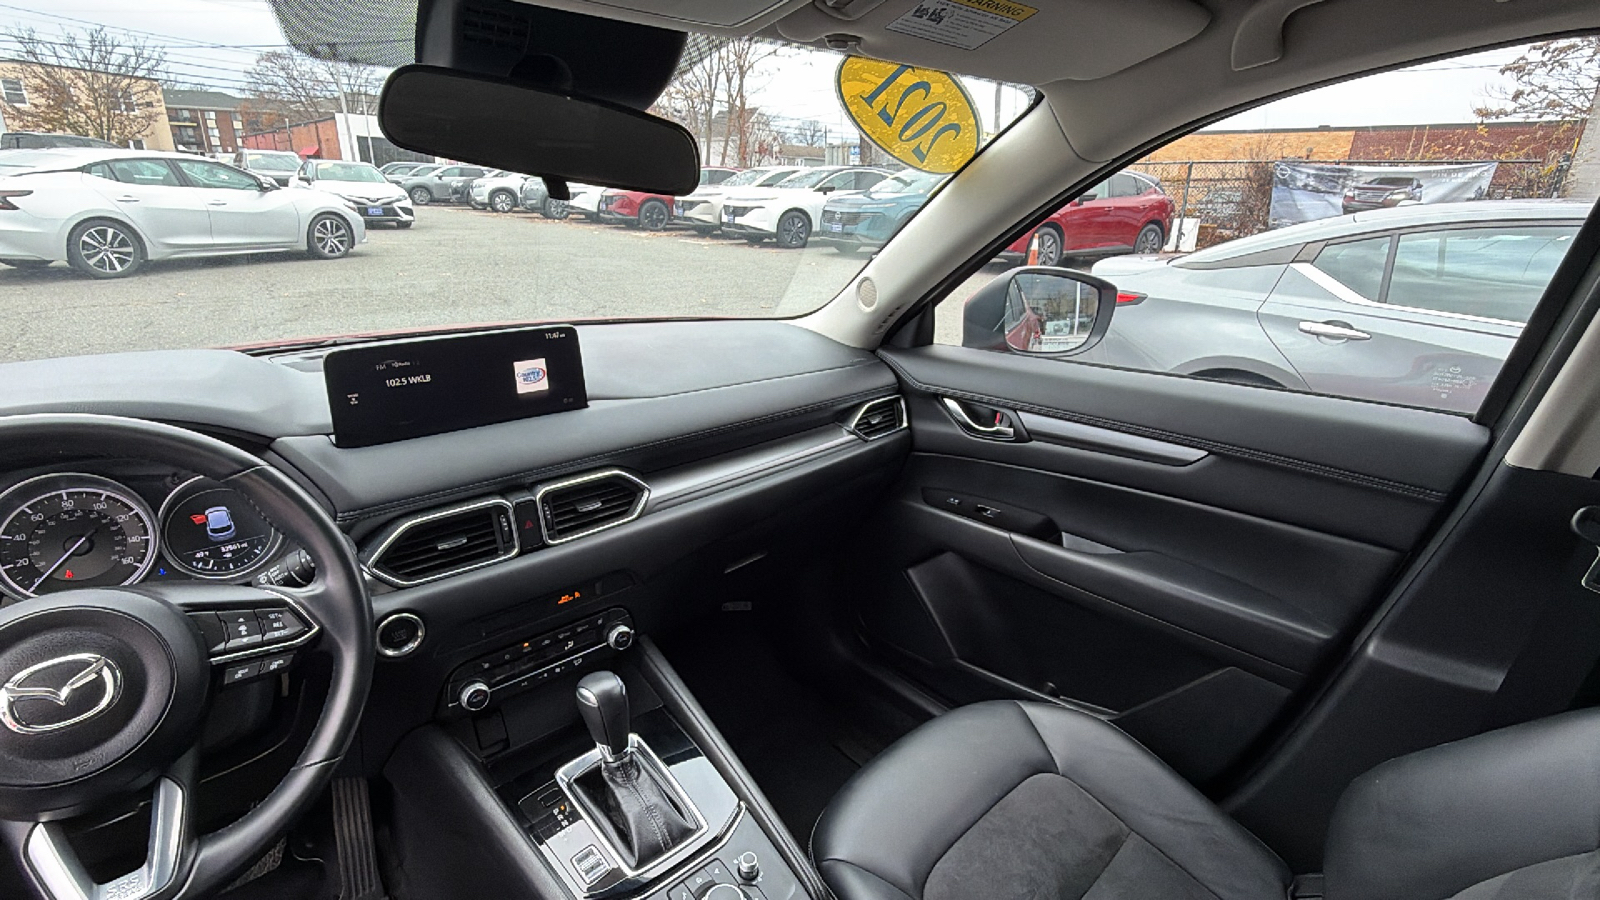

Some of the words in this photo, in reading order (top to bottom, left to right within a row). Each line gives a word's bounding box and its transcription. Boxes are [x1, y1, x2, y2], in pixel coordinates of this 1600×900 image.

[385, 377, 408, 388] 102.5
[408, 374, 432, 385] WKLB
[61, 500, 74, 508] 80
[93, 502, 107, 510] 100
[31, 513, 44, 522] 60
[116, 515, 129, 523] 120
[13, 533, 26, 541] 40
[127, 535, 140, 543] 140
[15, 558, 29, 567] 20
[121, 556, 134, 565] 160
[107, 874, 141, 893] SRS
